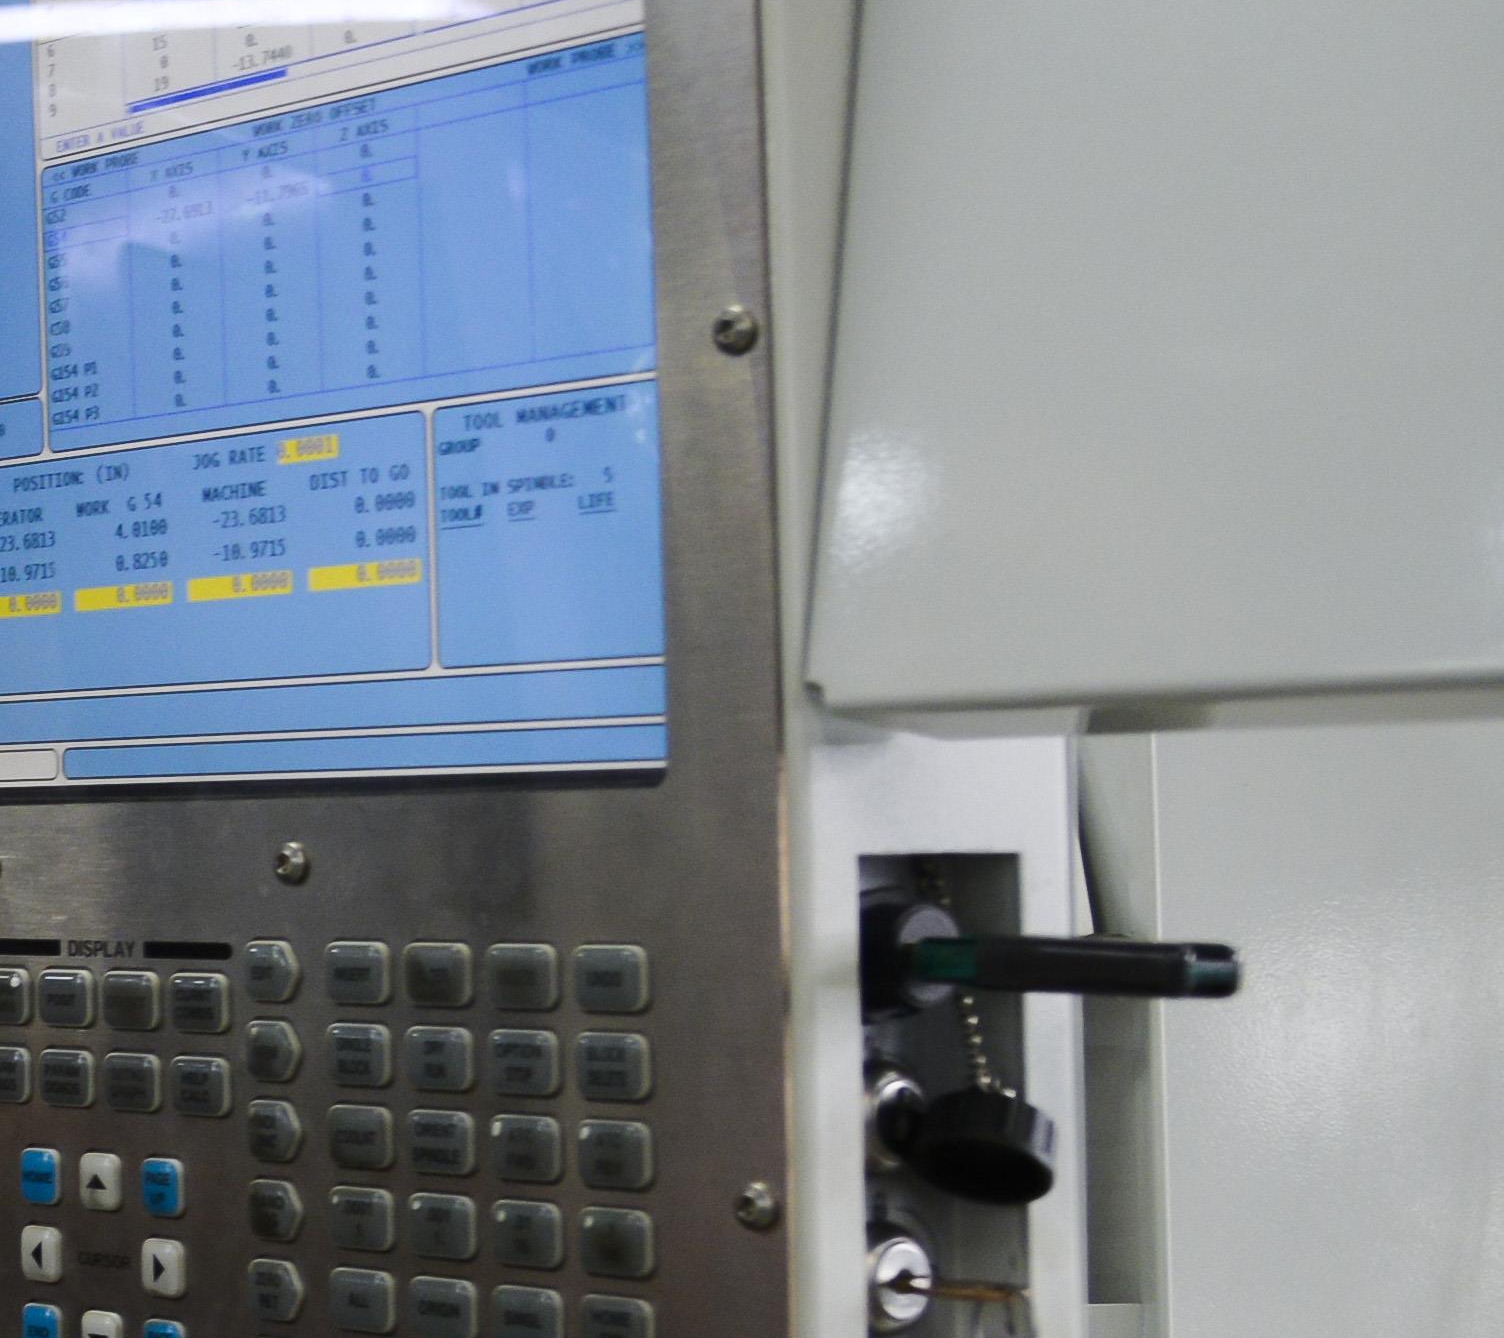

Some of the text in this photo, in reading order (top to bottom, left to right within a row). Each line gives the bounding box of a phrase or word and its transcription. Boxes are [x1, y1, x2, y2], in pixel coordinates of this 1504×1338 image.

[462, 393, 625, 431] TOOL MANAGEMENT
[192, 451, 221, 470] JOG
[228, 445, 267, 466] RATE
[12, 462, 130, 493] POSITION: (IN)
[308, 463, 410, 491] DIST TO GO
[482, 481, 500, 497] IN
[75, 491, 163, 518] WORK G 54
[201, 480, 267, 503] MACHINE
[114, 518, 168, 540] 4.0100
[212, 504, 287, 529] -23.6813
[114, 550, 169, 572] 0.8250
[212, 538, 286, 562] -10.9715
[67, 939, 136, 958] DISPLAY
[77, 1251, 130, 1269] CURSOR
